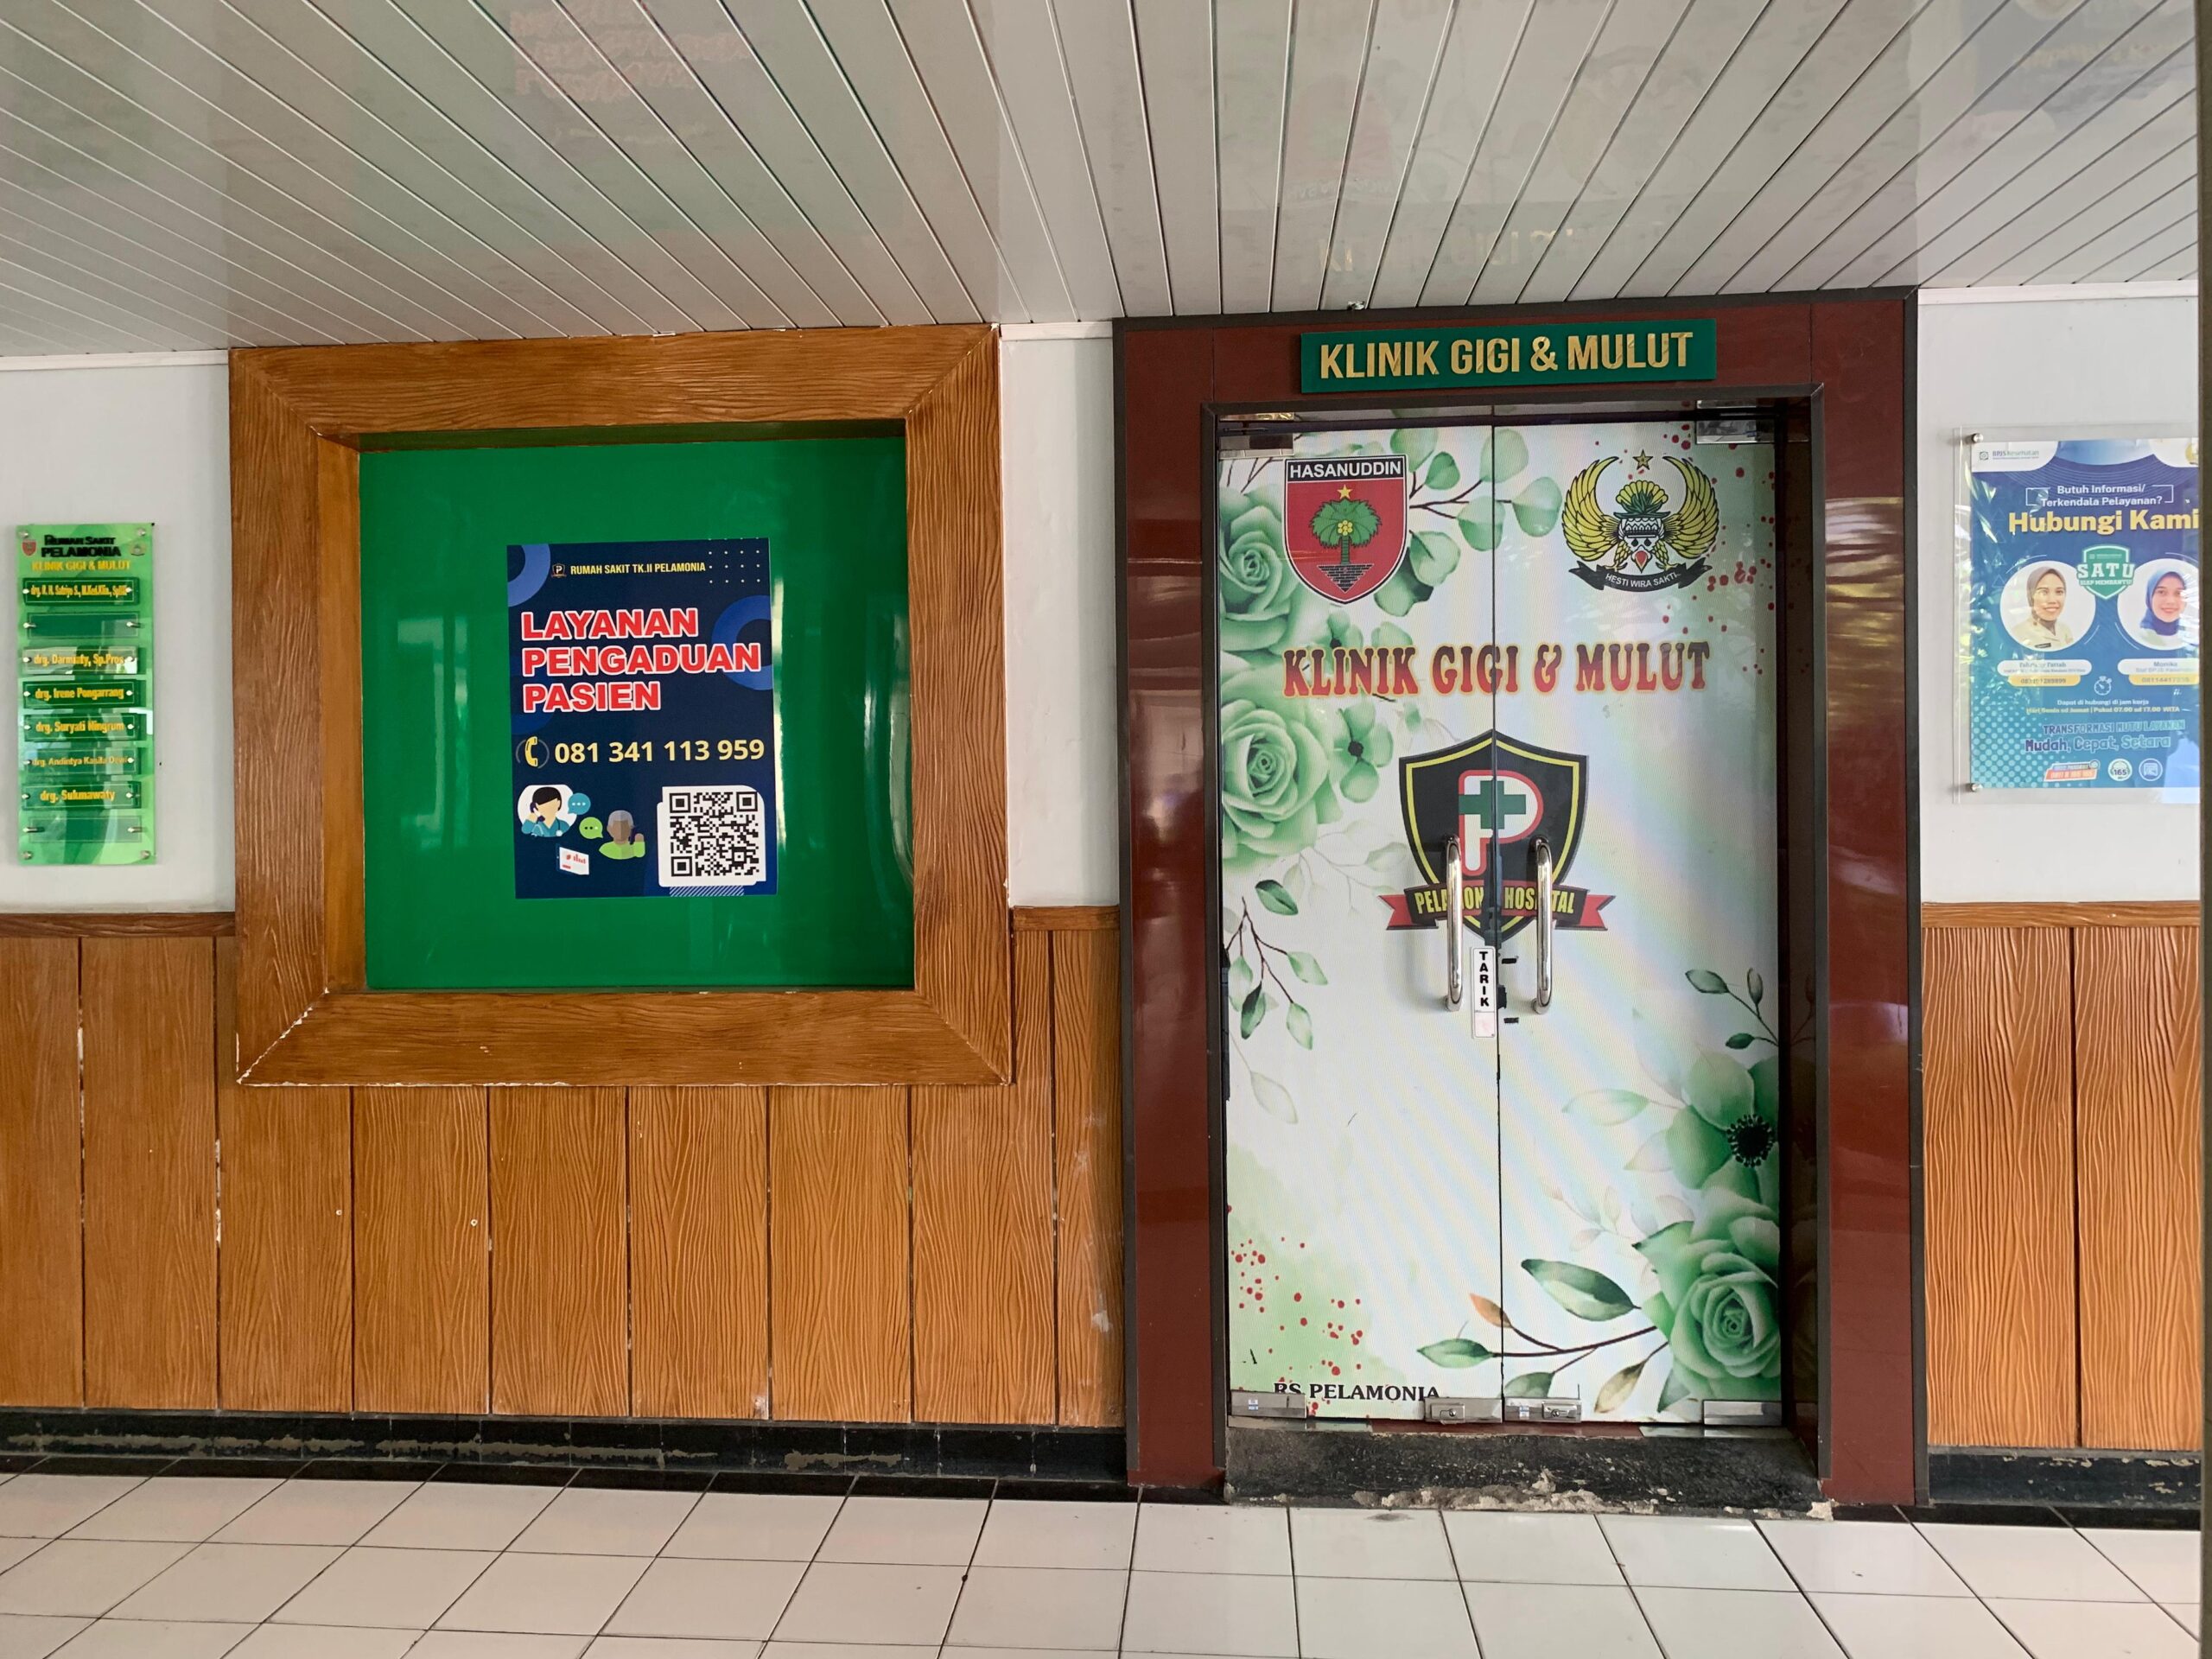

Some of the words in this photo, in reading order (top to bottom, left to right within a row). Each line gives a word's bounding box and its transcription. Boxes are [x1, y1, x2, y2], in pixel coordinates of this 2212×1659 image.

[1320, 340, 1440, 379] KLINIK
[1450, 338, 1521, 375] GIGI
[1529, 337, 1559, 372] &
[1567, 331, 1694, 371] MULUT
[1289, 461, 1402, 480] HASANUDDIN
[2057, 485, 2088, 494] Butuh
[2092, 483, 2145, 493] Informasi/
[2041, 497, 2100, 507] Terkendala
[2101, 495, 2163, 507] Pelayanan?
[2009, 510, 2122, 536] Hubungi
[2129, 508, 2199, 531] Kami
[41, 546, 121, 557] PELAMONIA
[31, 561, 64, 571] KLINIK
[66, 561, 86, 570] GIGI
[88, 561, 96, 570] &
[98, 560, 130, 570] MULUT
[570, 565, 602, 575] RUMAH
[604, 564, 630, 574] SAKIT
[632, 563, 653, 574] TK.II
[654, 562, 706, 573] PELAMONIA
[2076, 563, 2135, 579] SATU
[1605, 573, 1629, 587] HESTI
[1653, 571, 1677, 586] SAKTI
[521, 607, 698, 641] LAYANAN
[34, 654, 50, 667] drg.
[522, 643, 761, 677] PENGADUAN
[1283, 646, 1420, 697] KLINIK
[1431, 645, 1520, 696] GIGI
[1533, 643, 1563, 695] &
[1575, 640, 1710, 694] MULUT
[35, 689, 52, 702] drg.
[54, 688, 75, 698] Irene
[523, 681, 661, 713] PASIEN
[35, 721, 53, 735] drg.
[54, 721, 86, 734] Suryati
[87, 720, 125, 733] Ningrum
[2043, 723, 2114, 734] TRANSFORMASI
[2116, 721, 2143, 733] MUTU
[2143, 719, 2186, 731] LAYANAN
[554, 741, 599, 764] 081
[608, 741, 653, 763] 341
[664, 740, 710, 762] 113
[717, 739, 765, 761] 959
[2025, 738, 2071, 753] Mudah,
[2074, 735, 2120, 753] Cepat,
[2121, 734, 2171, 749] Setara
[40, 791, 59, 804] drg.
[61, 789, 116, 802] Sukmawaty
[1504, 887, 1574, 914] HOSTAL
[1478, 950, 1490, 1007] TARIK
[1274, 1382, 1301, 1394] RS
[1310, 1384, 1440, 1402] PELAMONIA
